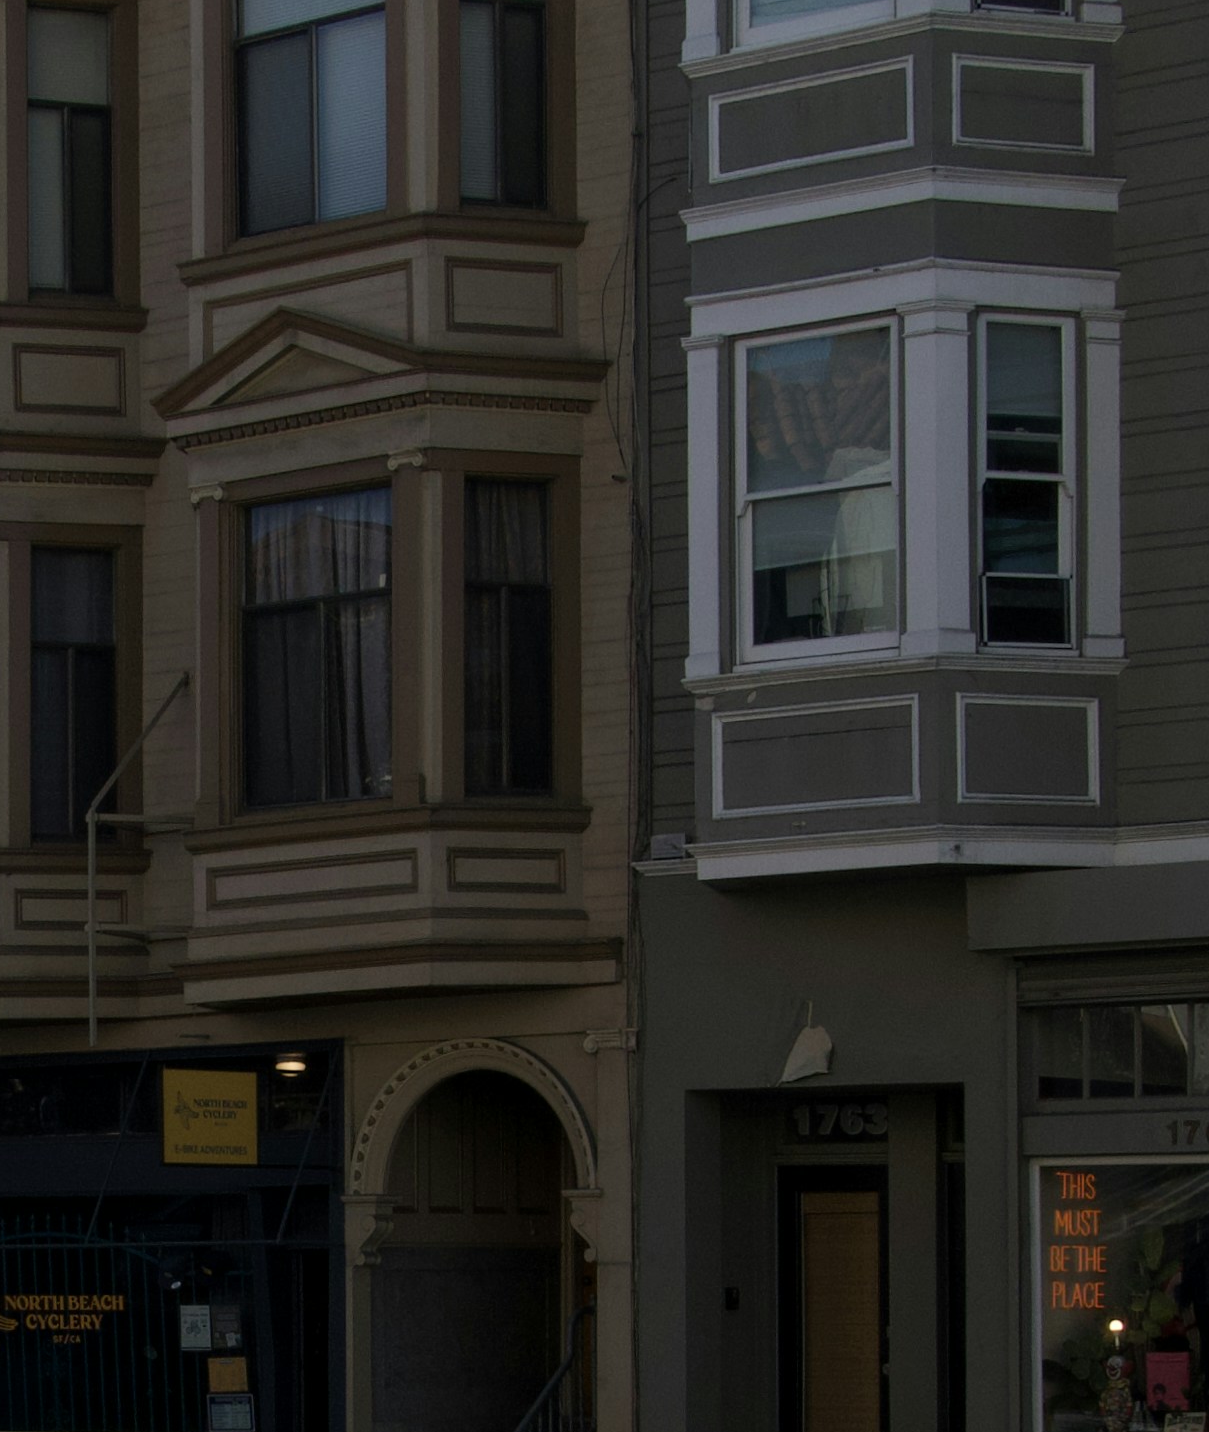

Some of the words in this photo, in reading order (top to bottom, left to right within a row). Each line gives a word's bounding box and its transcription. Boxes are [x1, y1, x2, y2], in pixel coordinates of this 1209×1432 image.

[193, 1098, 221, 1108] NORTH
[222, 1100, 248, 1109] BEACH
[203, 1110, 238, 1119] CYCLERY
[793, 1103, 887, 1135] 1763
[1166, 1119, 1209, 1145] 17
[200, 1145, 248, 1155] ADVENTURES
[1055, 1171, 1097, 1200] THIS
[1055, 1209, 1102, 1237] MUST
[1050, 1245, 1071, 1272] BE
[1072, 1245, 1107, 1272] THE
[4, 1294, 64, 1311] NORTH
[67, 1294, 125, 1311] BEACH
[1052, 1281, 1105, 1309] PLACE
[25, 1313, 103, 1330] CYCLERY
